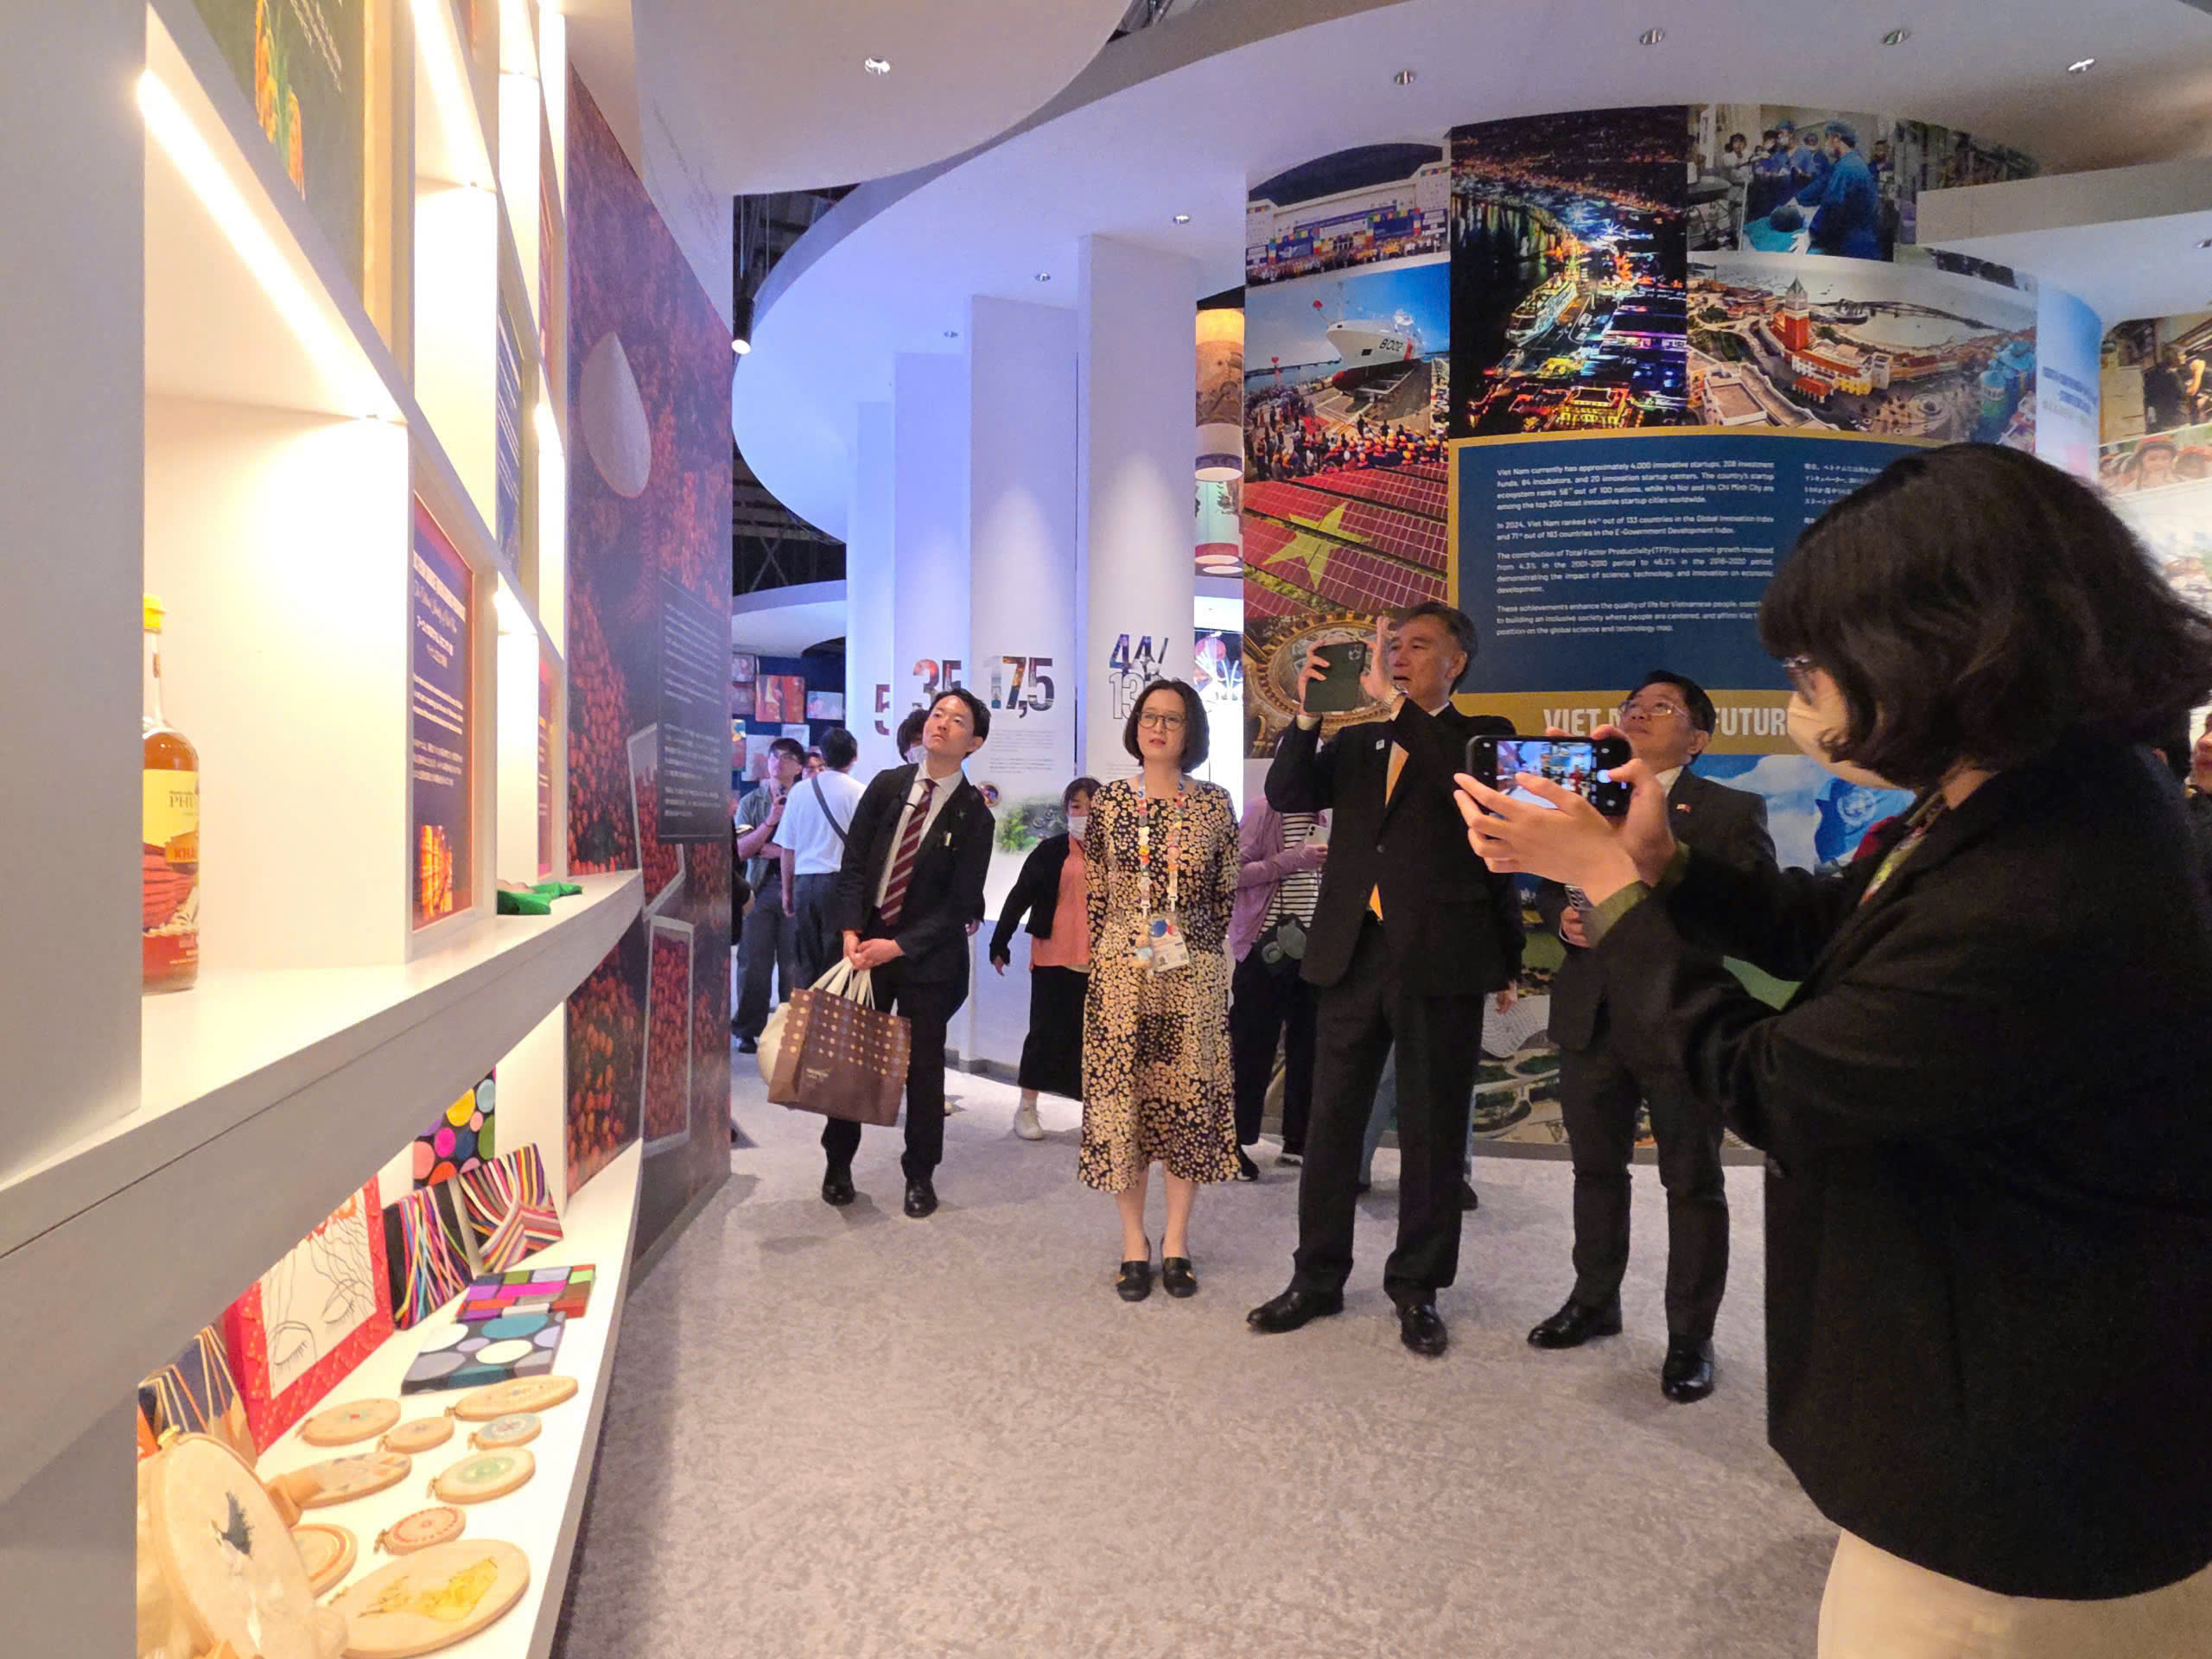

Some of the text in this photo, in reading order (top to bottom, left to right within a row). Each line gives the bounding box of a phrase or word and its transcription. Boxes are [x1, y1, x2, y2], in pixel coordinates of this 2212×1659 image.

[1109, 671, 1162, 719] 13
[1543, 709, 1601, 736] VIET
[1715, 708, 1789, 736] FUTUR
